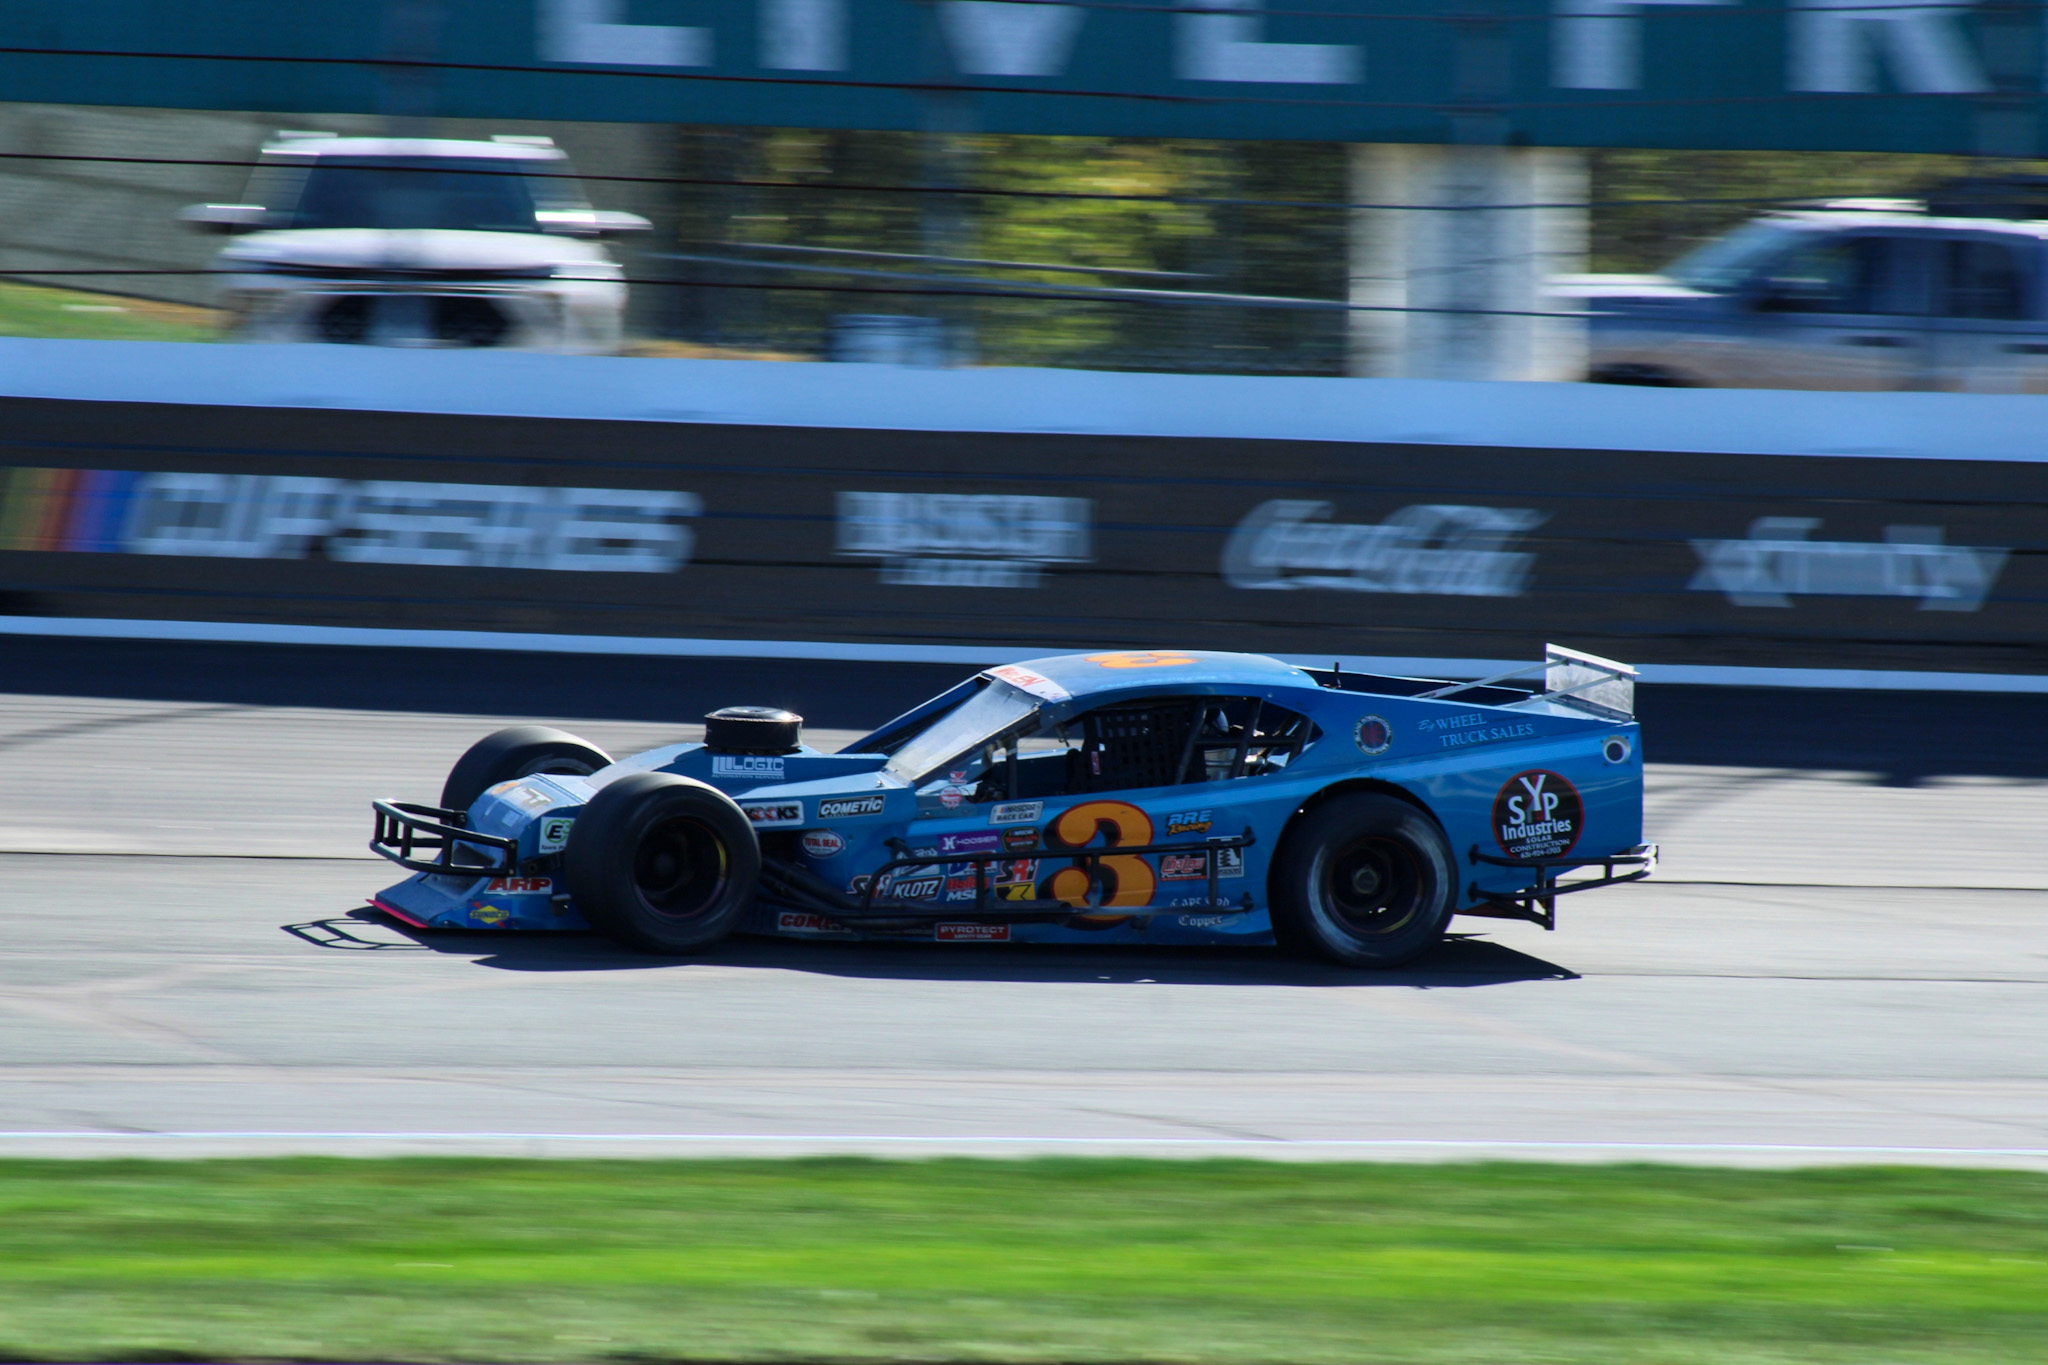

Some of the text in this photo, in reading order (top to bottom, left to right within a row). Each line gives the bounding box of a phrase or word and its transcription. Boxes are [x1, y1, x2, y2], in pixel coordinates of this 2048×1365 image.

[1436, 713, 1487, 730] WHEEL
[1439, 723, 1535, 747] TRUCK SALES
[997, 813, 1016, 821] RACE
[1502, 818, 1572, 840] Industries
[823, 839, 839, 848] SEAL
[956, 835, 998, 845] HOOSIER
[1510, 839, 1571, 853] CONSTRUCTION
[1526, 834, 1552, 844] SOLAR
[1048, 800, 1156, 925] 3
[488, 877, 551, 891] ARP
[894, 880, 939, 898] KLOTZ
[1178, 914, 1222, 928] Copper
[940, 926, 1004, 934] PYROTECT
